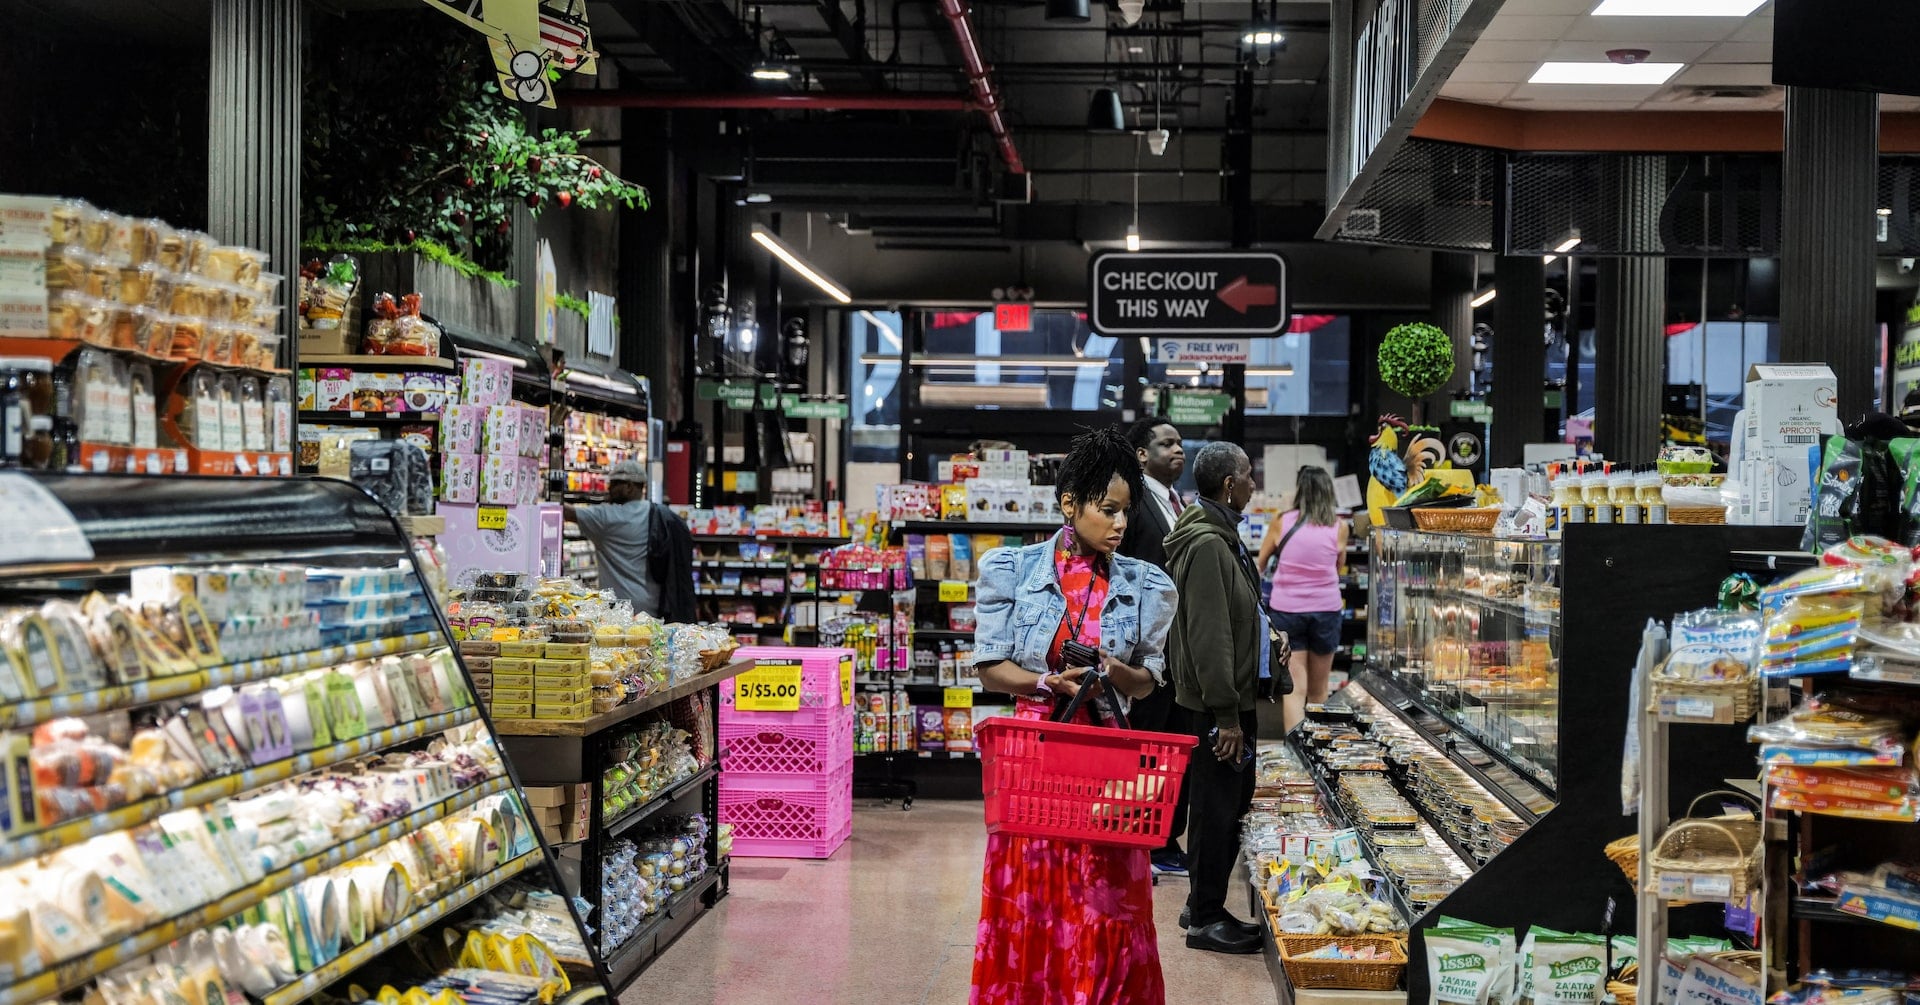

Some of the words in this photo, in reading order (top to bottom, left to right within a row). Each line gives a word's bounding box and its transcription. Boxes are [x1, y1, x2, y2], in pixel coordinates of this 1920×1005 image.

[1103, 271, 1218, 291] CHECKOUT
[1116, 299, 1158, 318] THIS
[1164, 299, 1209, 318] WAY
[998, 305, 1030, 329] EXIT
[1187, 343, 1213, 352] FREE
[1216, 343, 1239, 352] WIFI
[1172, 396, 1214, 407] Midtown
[1780, 426, 1822, 434] APRICOTS
[741, 682, 797, 698] 5/$5.00
[1443, 954, 1481, 970] issa's
[1555, 959, 1596, 977] issa's
[1441, 975, 1477, 987] ZA'ATAR
[1555, 982, 1595, 990] ZA'ATAR
[1446, 985, 1476, 997] THYME
